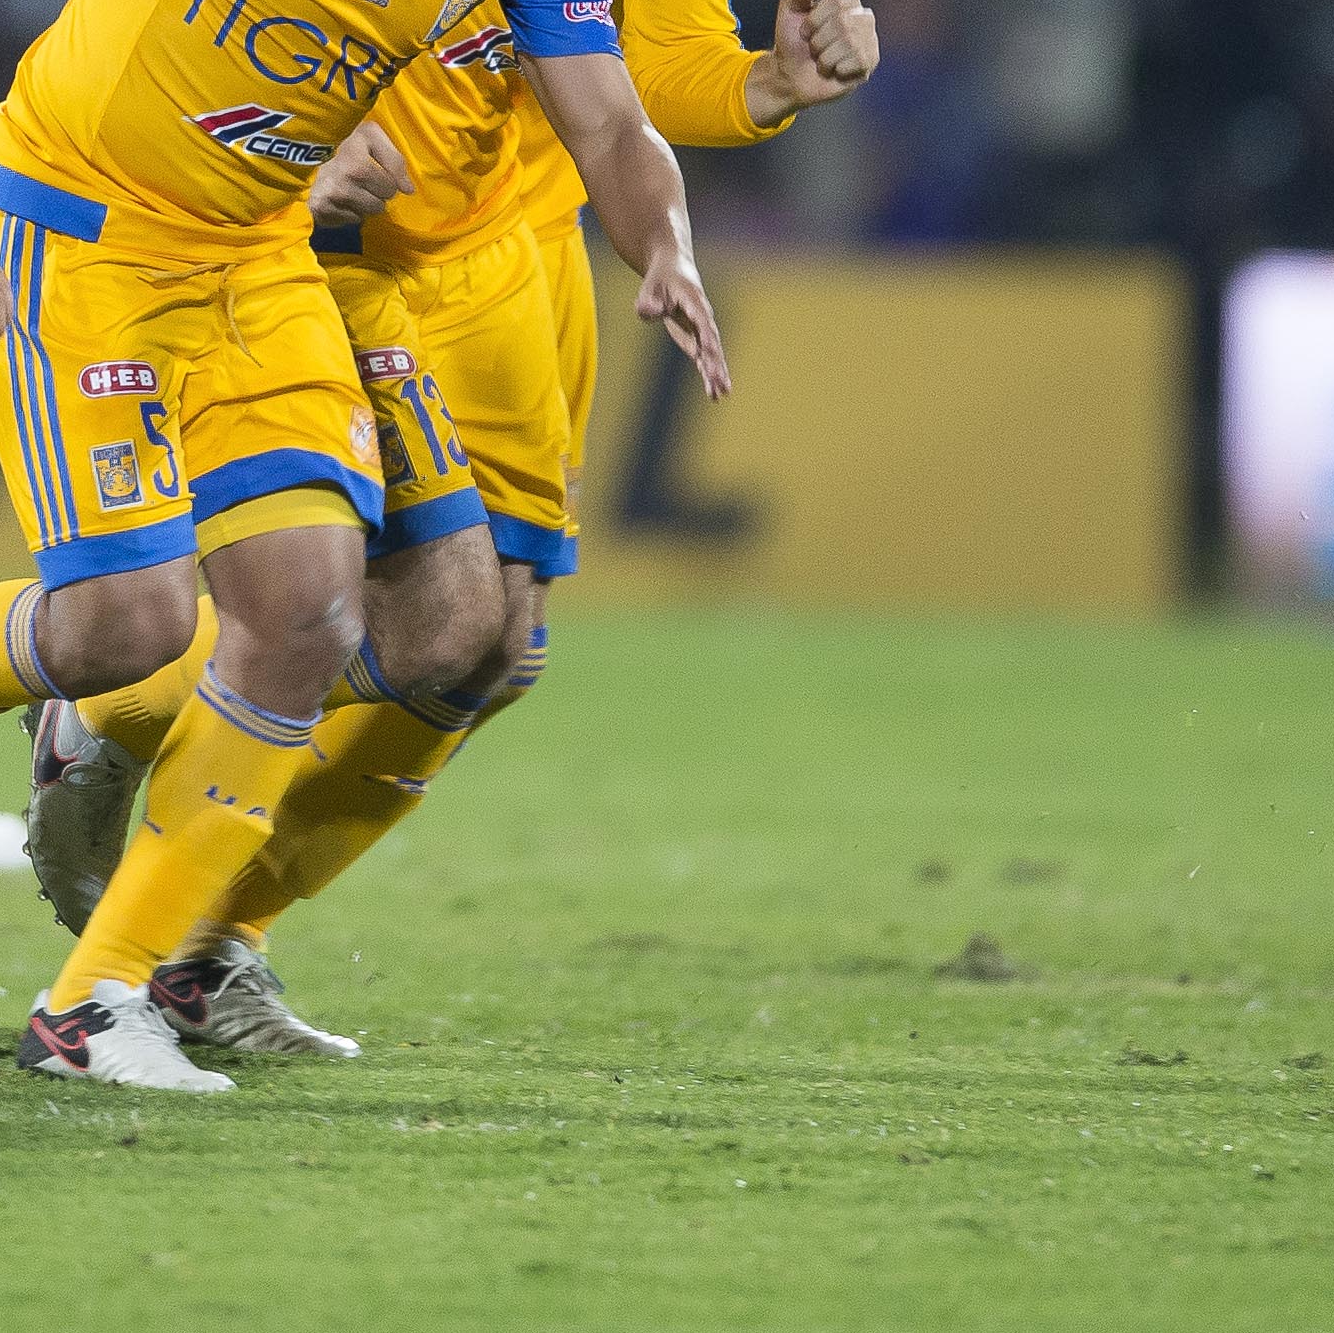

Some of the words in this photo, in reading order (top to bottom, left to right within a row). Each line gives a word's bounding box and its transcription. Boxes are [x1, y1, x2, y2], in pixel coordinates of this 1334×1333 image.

[245, 135, 335, 163] CEME
[139, 401, 179, 498] 5
[400, 373, 469, 477] 13
